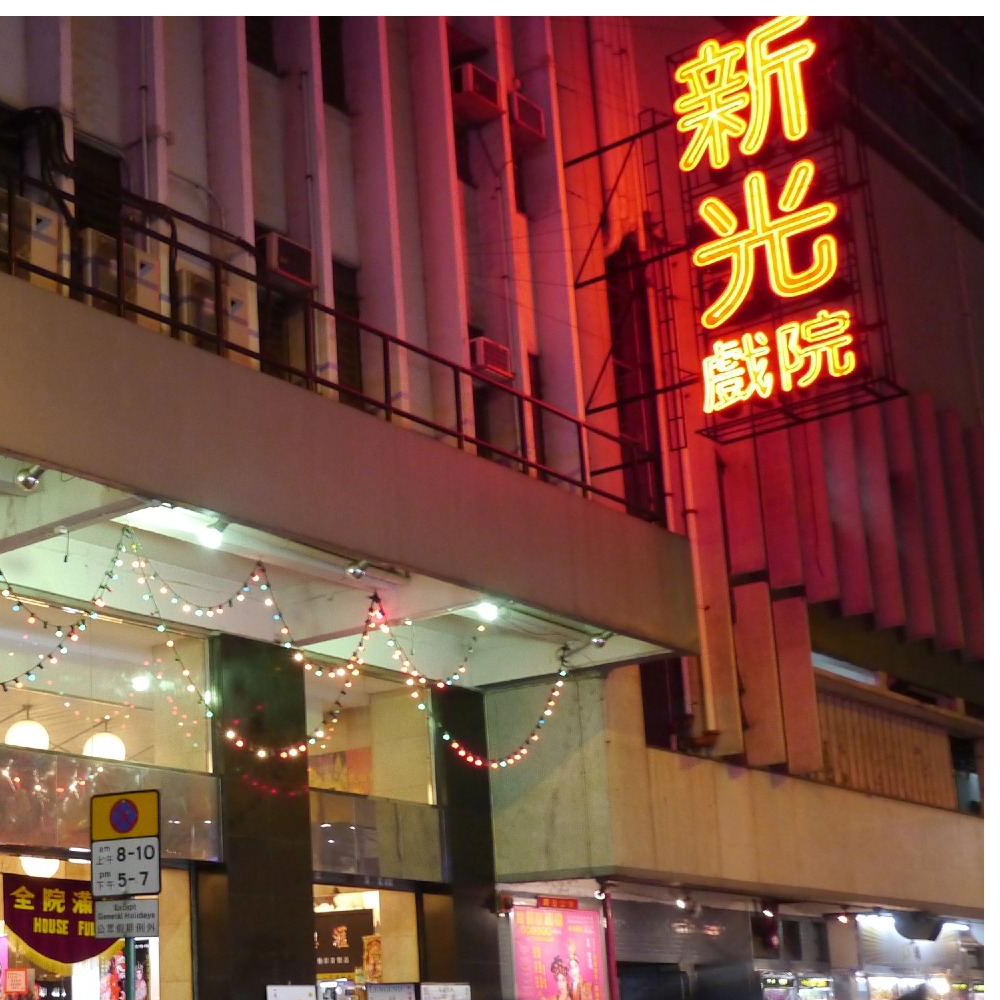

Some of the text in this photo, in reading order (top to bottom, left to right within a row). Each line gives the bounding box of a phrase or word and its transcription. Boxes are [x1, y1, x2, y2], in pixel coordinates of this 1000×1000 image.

[675, 16, 839, 328] 新光
[702, 309, 855, 413] 戲院
[96, 855, 114, 866] 上午
[116, 845, 155, 862] 8-10
[96, 881, 114, 890] 下午
[33, 917, 69, 935] HOUSE
